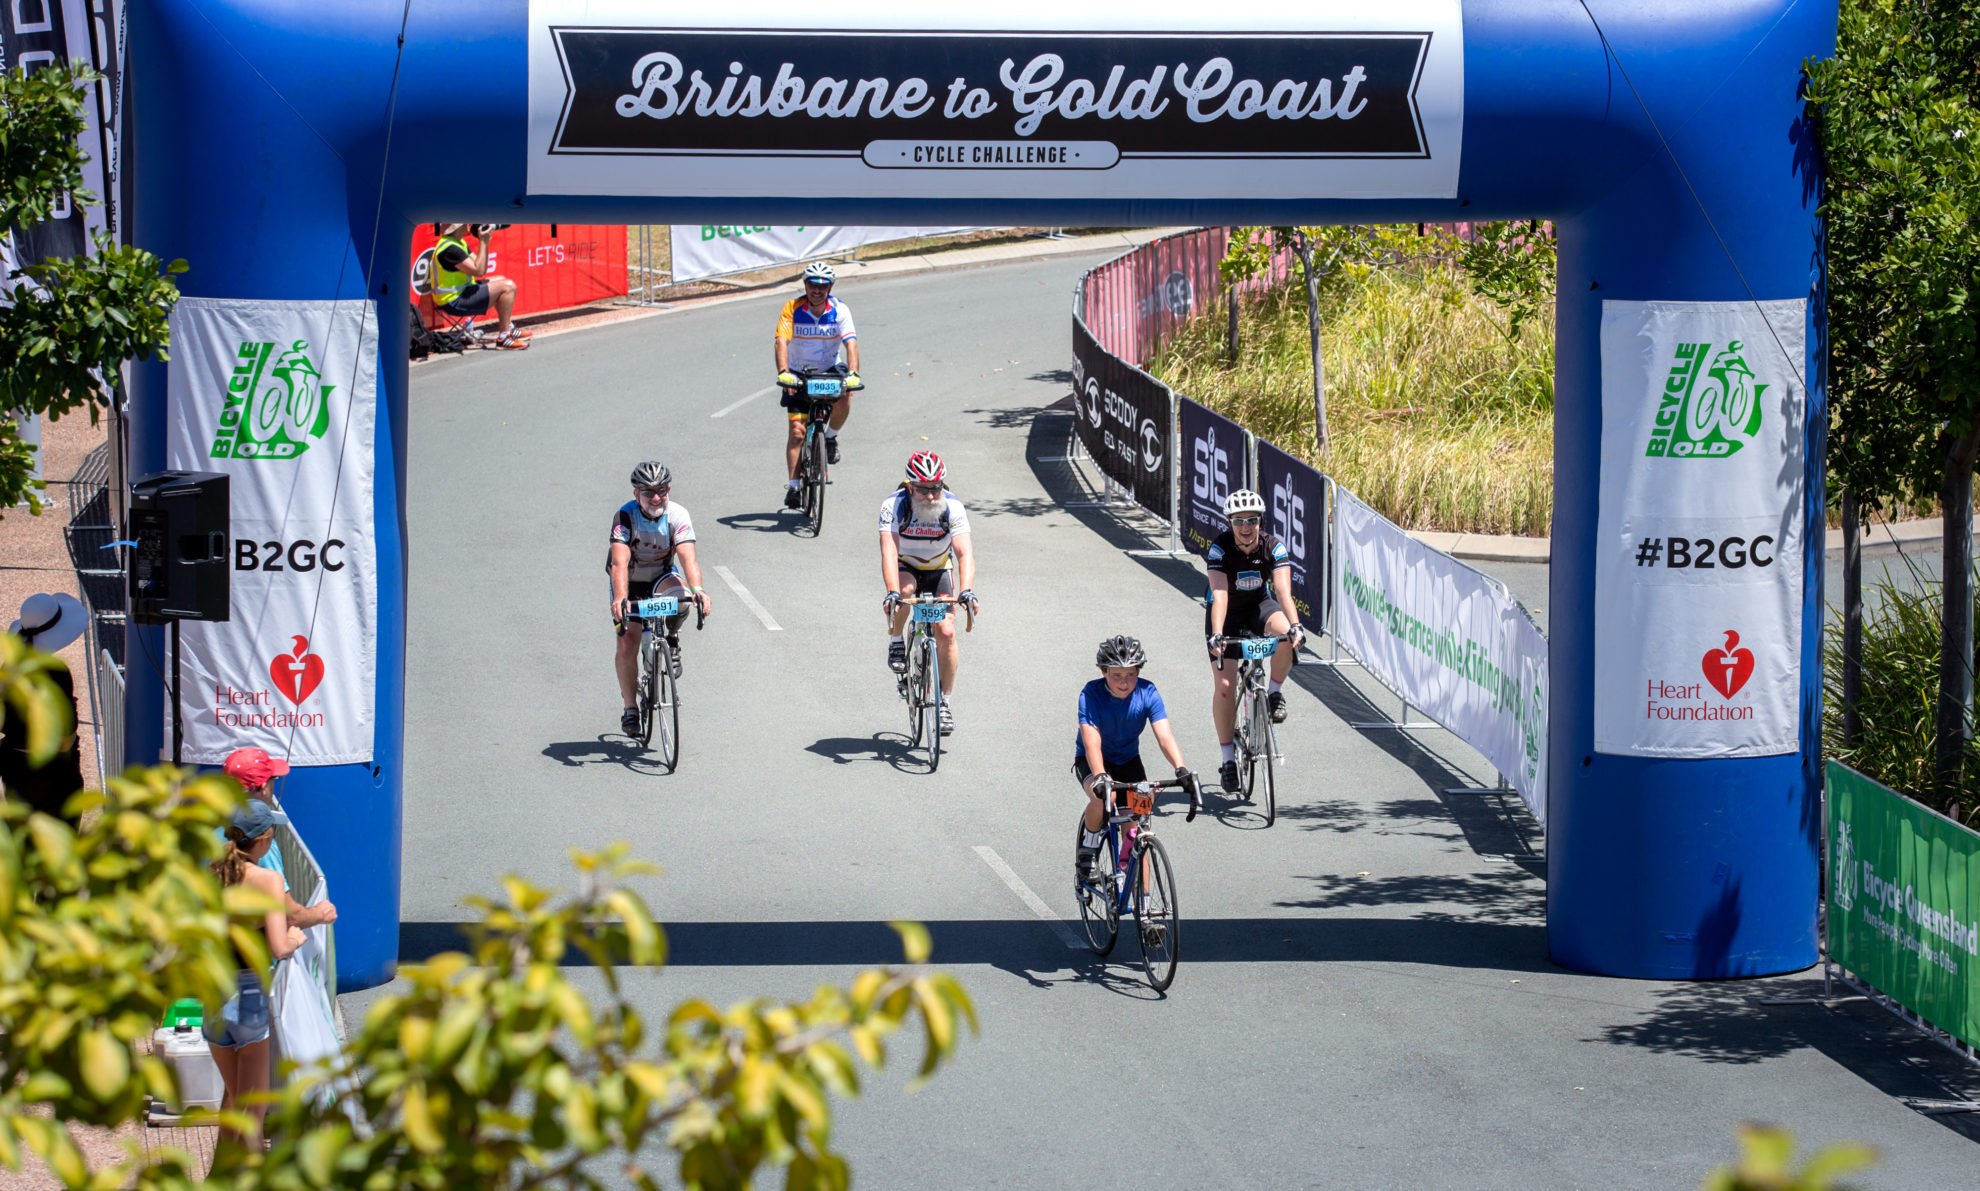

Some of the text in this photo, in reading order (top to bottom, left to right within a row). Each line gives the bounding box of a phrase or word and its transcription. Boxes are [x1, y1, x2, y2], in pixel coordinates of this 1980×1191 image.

[615, 51, 1368, 137] Brisbane to Gold Coast
[914, 145, 1067, 164] CYCLE CHALLENGE
[528, 241, 598, 267] LET'S RIDE
[210, 341, 260, 458] BICYCLE
[814, 382, 836, 391] 9035
[1104, 388, 1138, 432] SCODY
[1645, 343, 1697, 457] BICYCLE
[237, 442, 296, 457] QLD
[1118, 439, 1137, 467] FAST
[1672, 441, 1730, 456] QLD
[235, 538, 346, 573] B2GC
[1635, 535, 1774, 569] #B2GC
[647, 601, 672, 612] 9591
[215, 685, 270, 705] Heart
[1647, 679, 1702, 699] Heart
[215, 707, 323, 728] Foundation
[1647, 700, 1753, 721] Foundation
[1863, 859, 1903, 914] Bicycle
[1905, 884, 1978, 956] Queensland
[1863, 904, 1878, 929] More
[1922, 939, 1938, 965] More
[1939, 949, 1958, 976] Often
